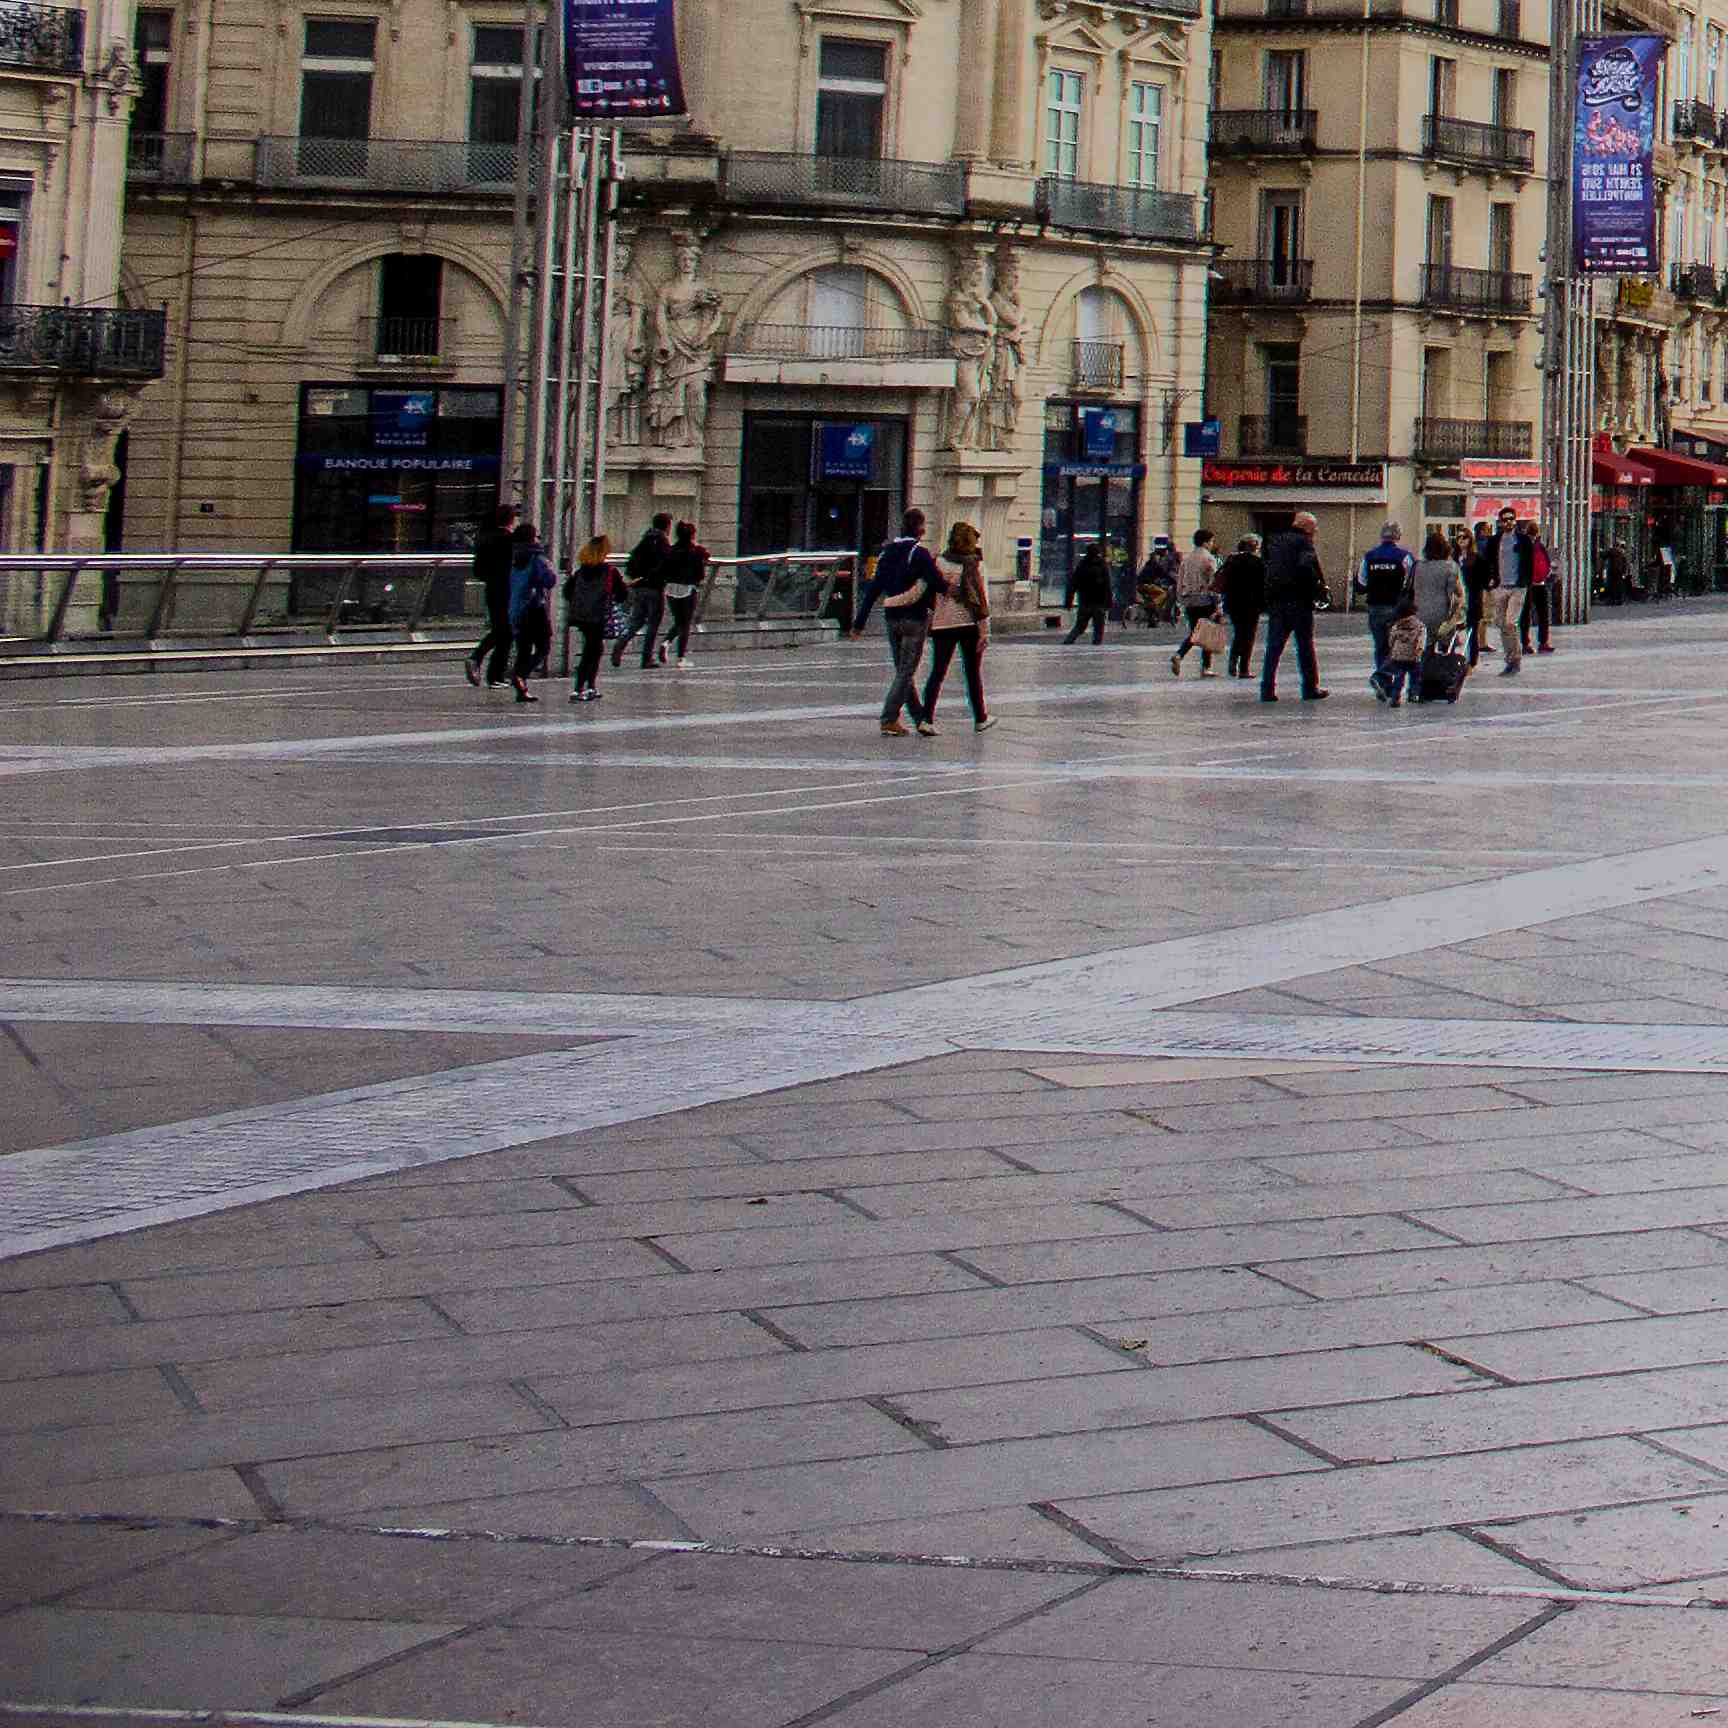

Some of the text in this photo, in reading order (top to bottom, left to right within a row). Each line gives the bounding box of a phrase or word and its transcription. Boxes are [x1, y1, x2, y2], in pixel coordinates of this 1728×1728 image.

[324, 458, 473, 470] BANQUE POPULAIRE
[1295, 465, 1313, 482] la
